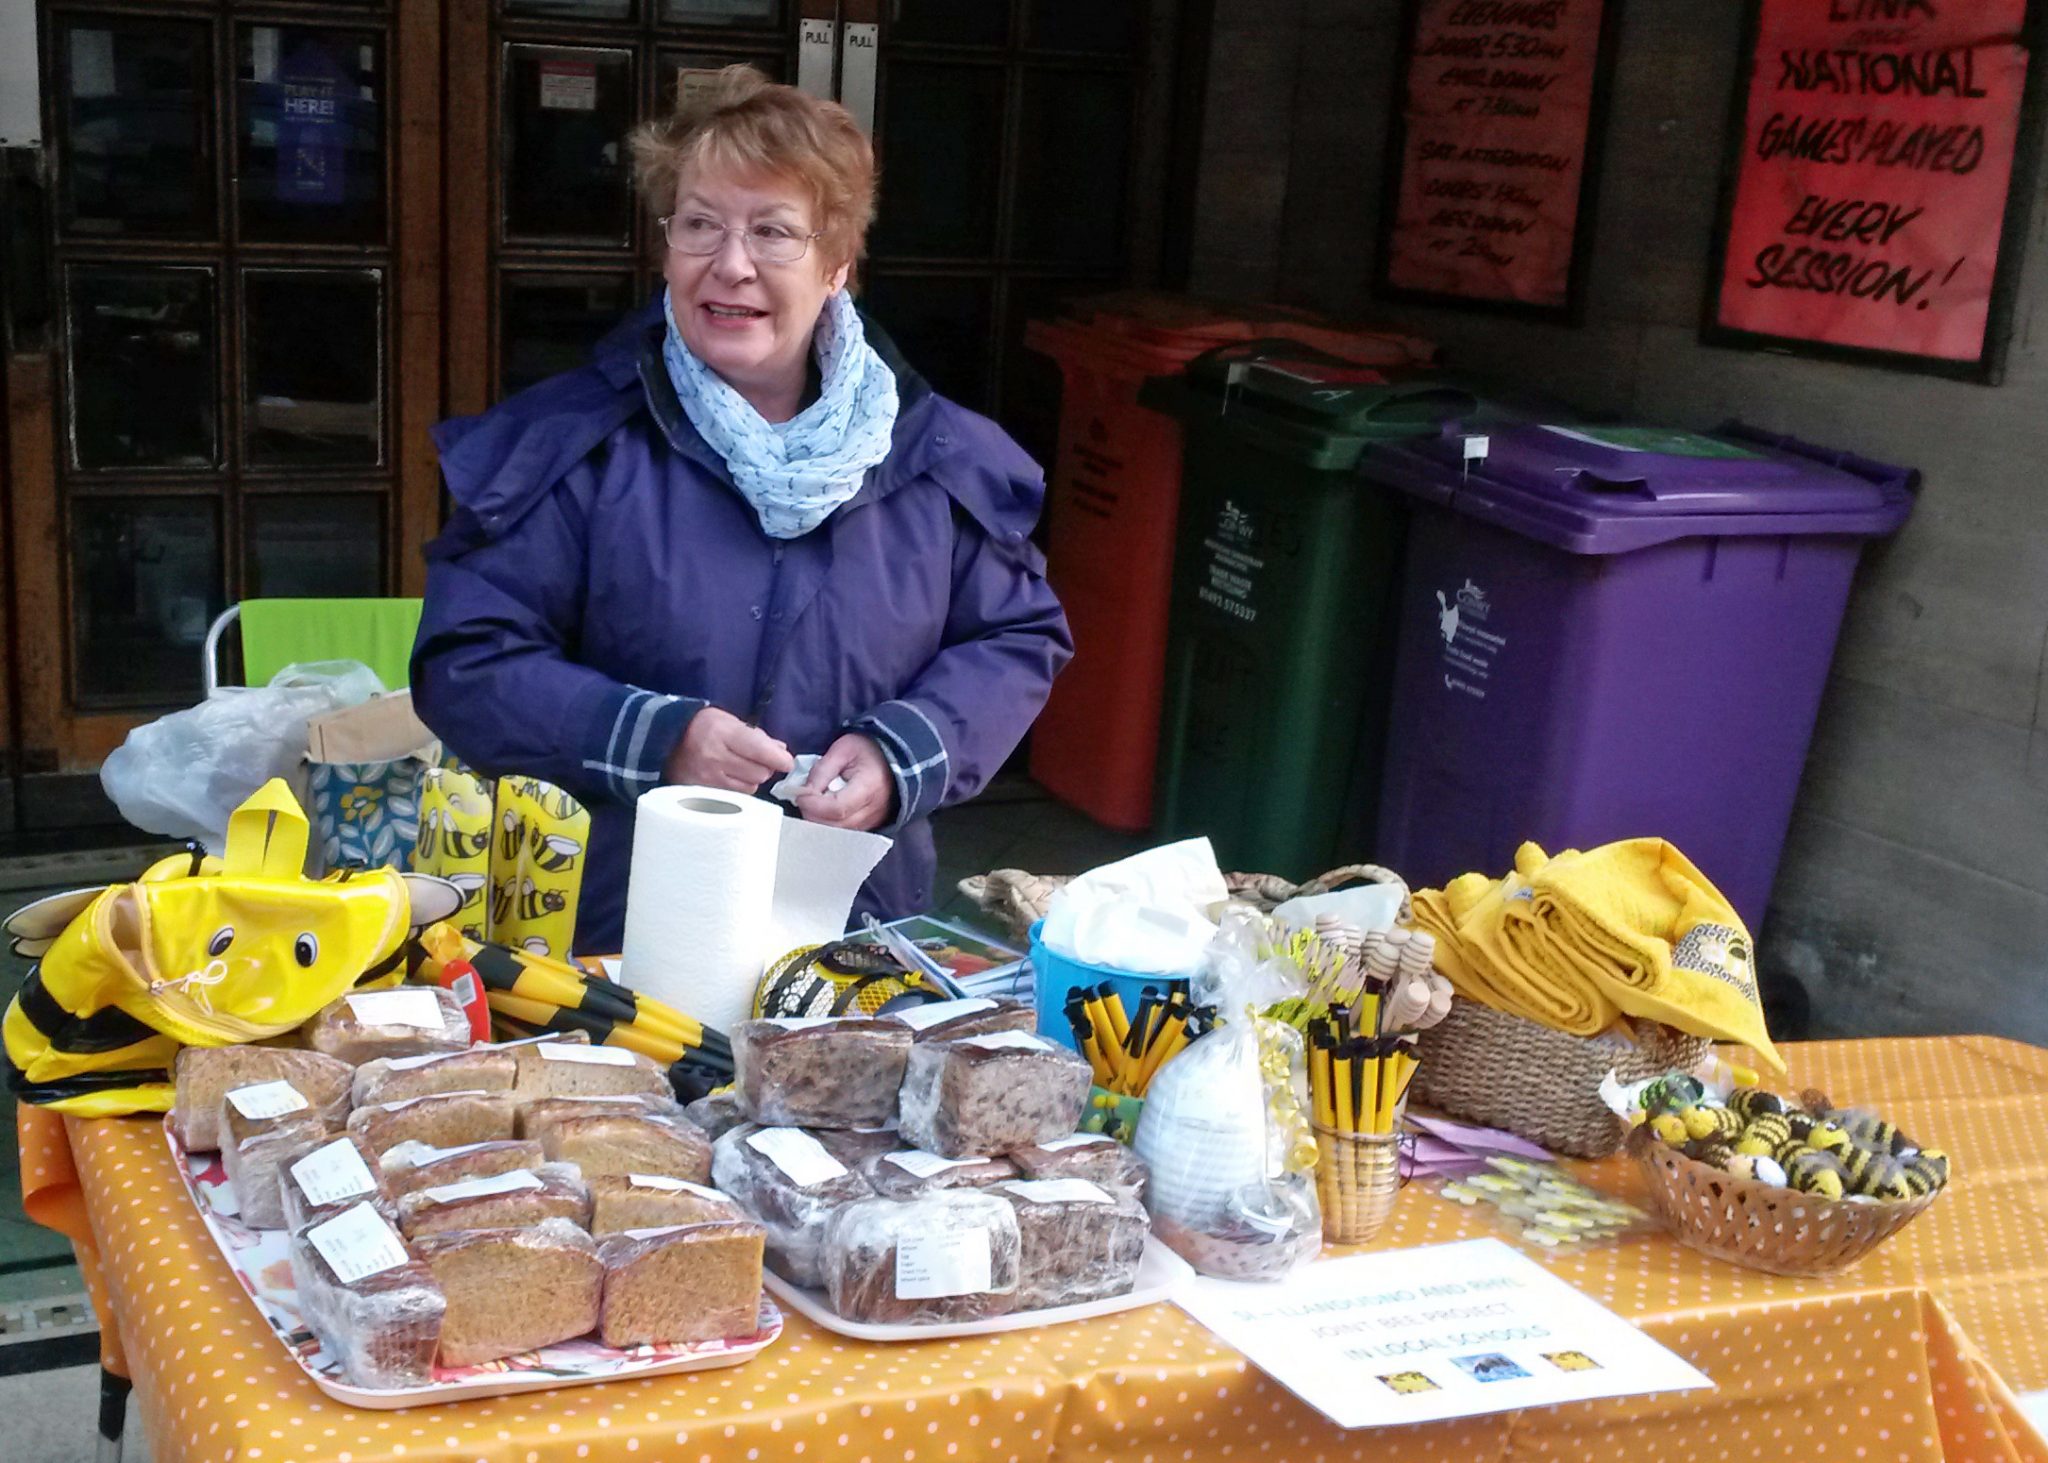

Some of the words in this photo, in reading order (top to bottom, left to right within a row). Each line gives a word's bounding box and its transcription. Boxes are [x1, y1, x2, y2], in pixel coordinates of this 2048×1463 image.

[805, 31, 829, 44] PULL
[849, 35, 873, 47] PULL
[1777, 48, 1986, 98] NATIONAL
[284, 98, 335, 115] HERE!
[1858, 117, 1985, 175] PLAYED
[1785, 195, 1925, 245] EVERY
[1276, 1289, 1417, 1318] LLANDUDNO
[1419, 1282, 1467, 1298] AND
[1312, 1320, 1374, 1339] JOINT
[1377, 1313, 1424, 1329] BEE
[1421, 1301, 1514, 1322] PROJECT
[1343, 1347, 1374, 1361] IN
[1375, 1337, 1449, 1357] LOCAL
[1447, 1323, 1552, 1347] SCHOOLS
